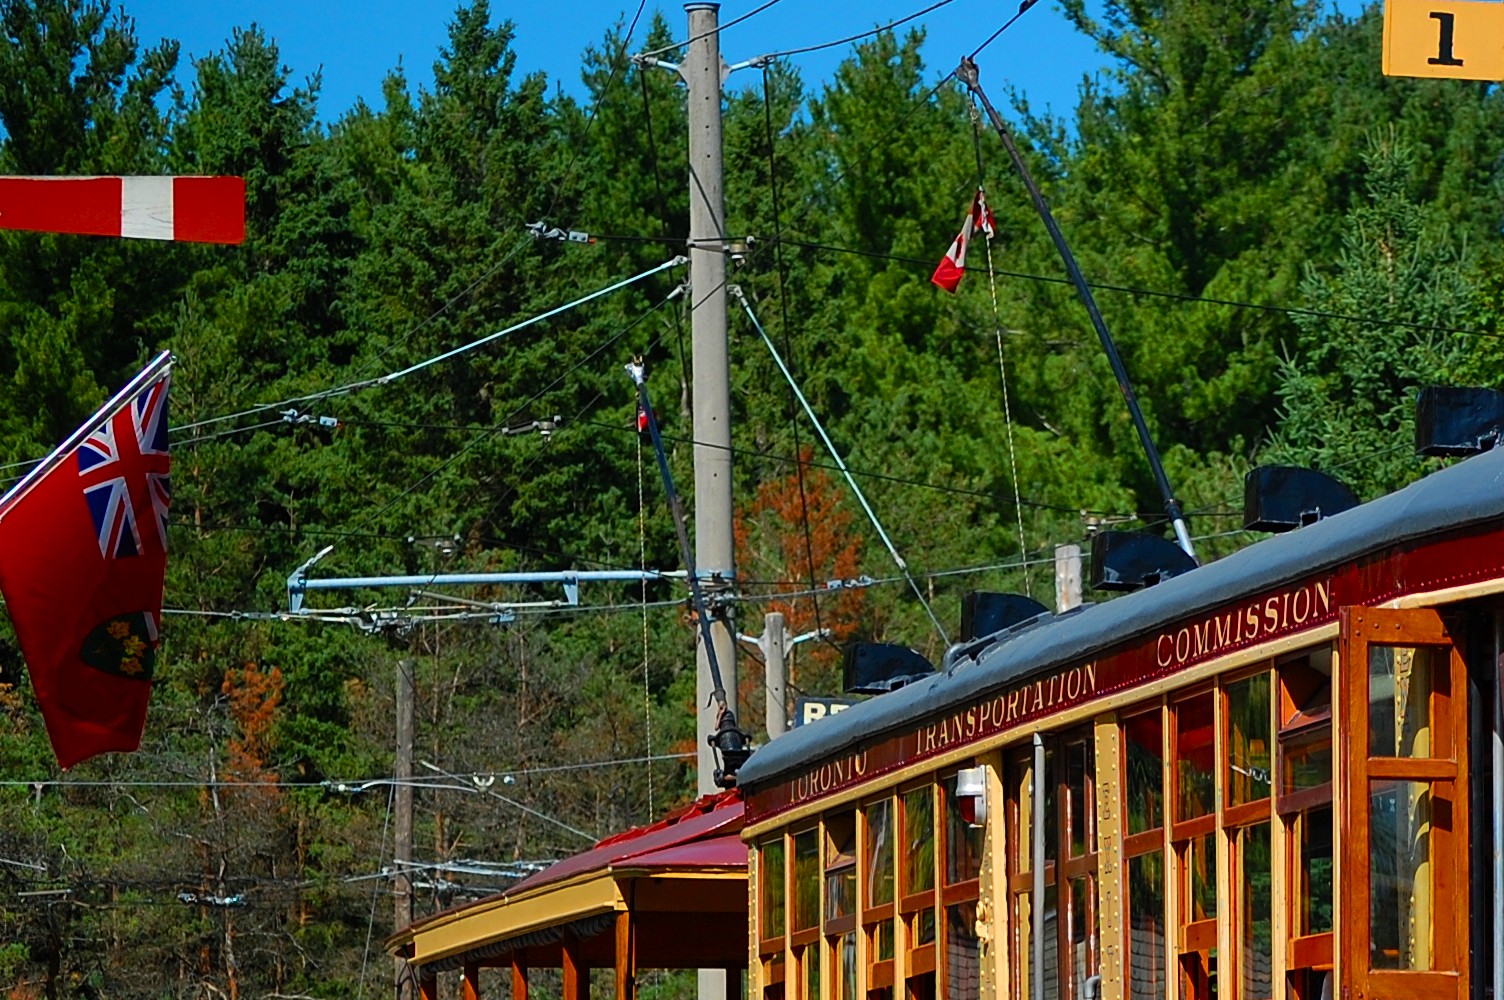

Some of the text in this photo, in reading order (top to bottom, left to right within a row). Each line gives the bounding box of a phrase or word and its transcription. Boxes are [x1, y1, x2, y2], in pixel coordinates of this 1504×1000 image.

[1427, 11, 1464, 67] 1
[790, 578, 1332, 803] TORONTO TRANSPORTATION COMMISSION
